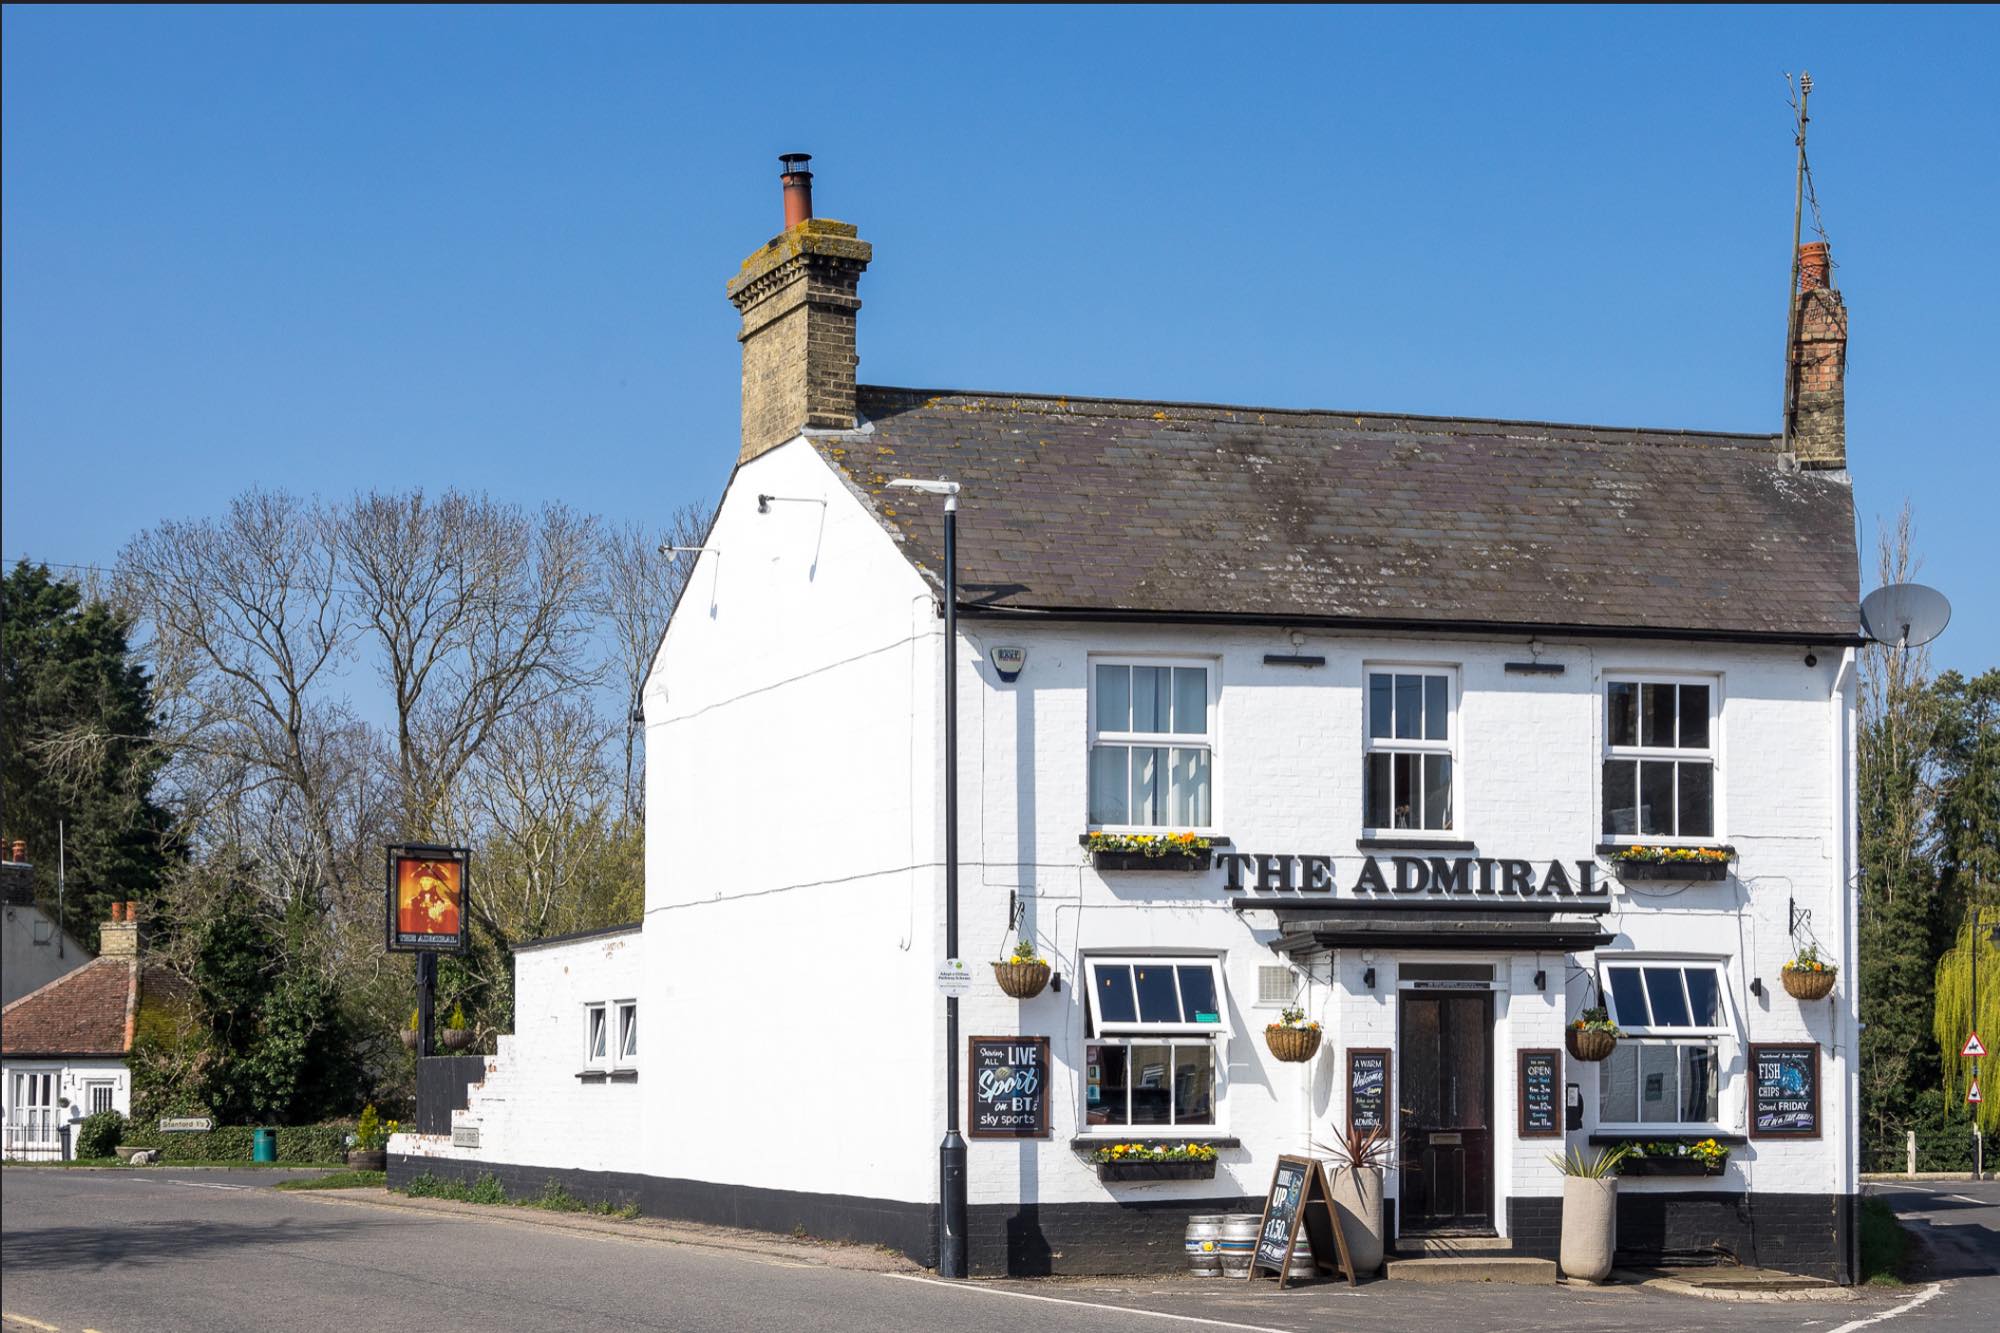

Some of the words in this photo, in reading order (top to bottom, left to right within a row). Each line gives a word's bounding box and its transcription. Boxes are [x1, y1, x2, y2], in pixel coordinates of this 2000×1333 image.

[1216, 853, 1332, 891] THE
[1351, 855, 1609, 897] ADMIRAL
[1008, 1046, 1036, 1065] LIVE
[1528, 1066, 1551, 1076] OPEN
[1758, 1063, 1780, 1079] FISH
[978, 1067, 1038, 1103] Sport
[1353, 1071, 1383, 1088] Welcome
[1758, 1087, 1780, 1097] CHIPS
[994, 1102, 1008, 1111] on
[1012, 1097, 1033, 1111] BT
[1778, 1101, 1809, 1111] FRIDAY
[980, 1112, 999, 1126] sky
[1001, 1114, 1035, 1125] sports
[1272, 1186, 1288, 1207] UP
